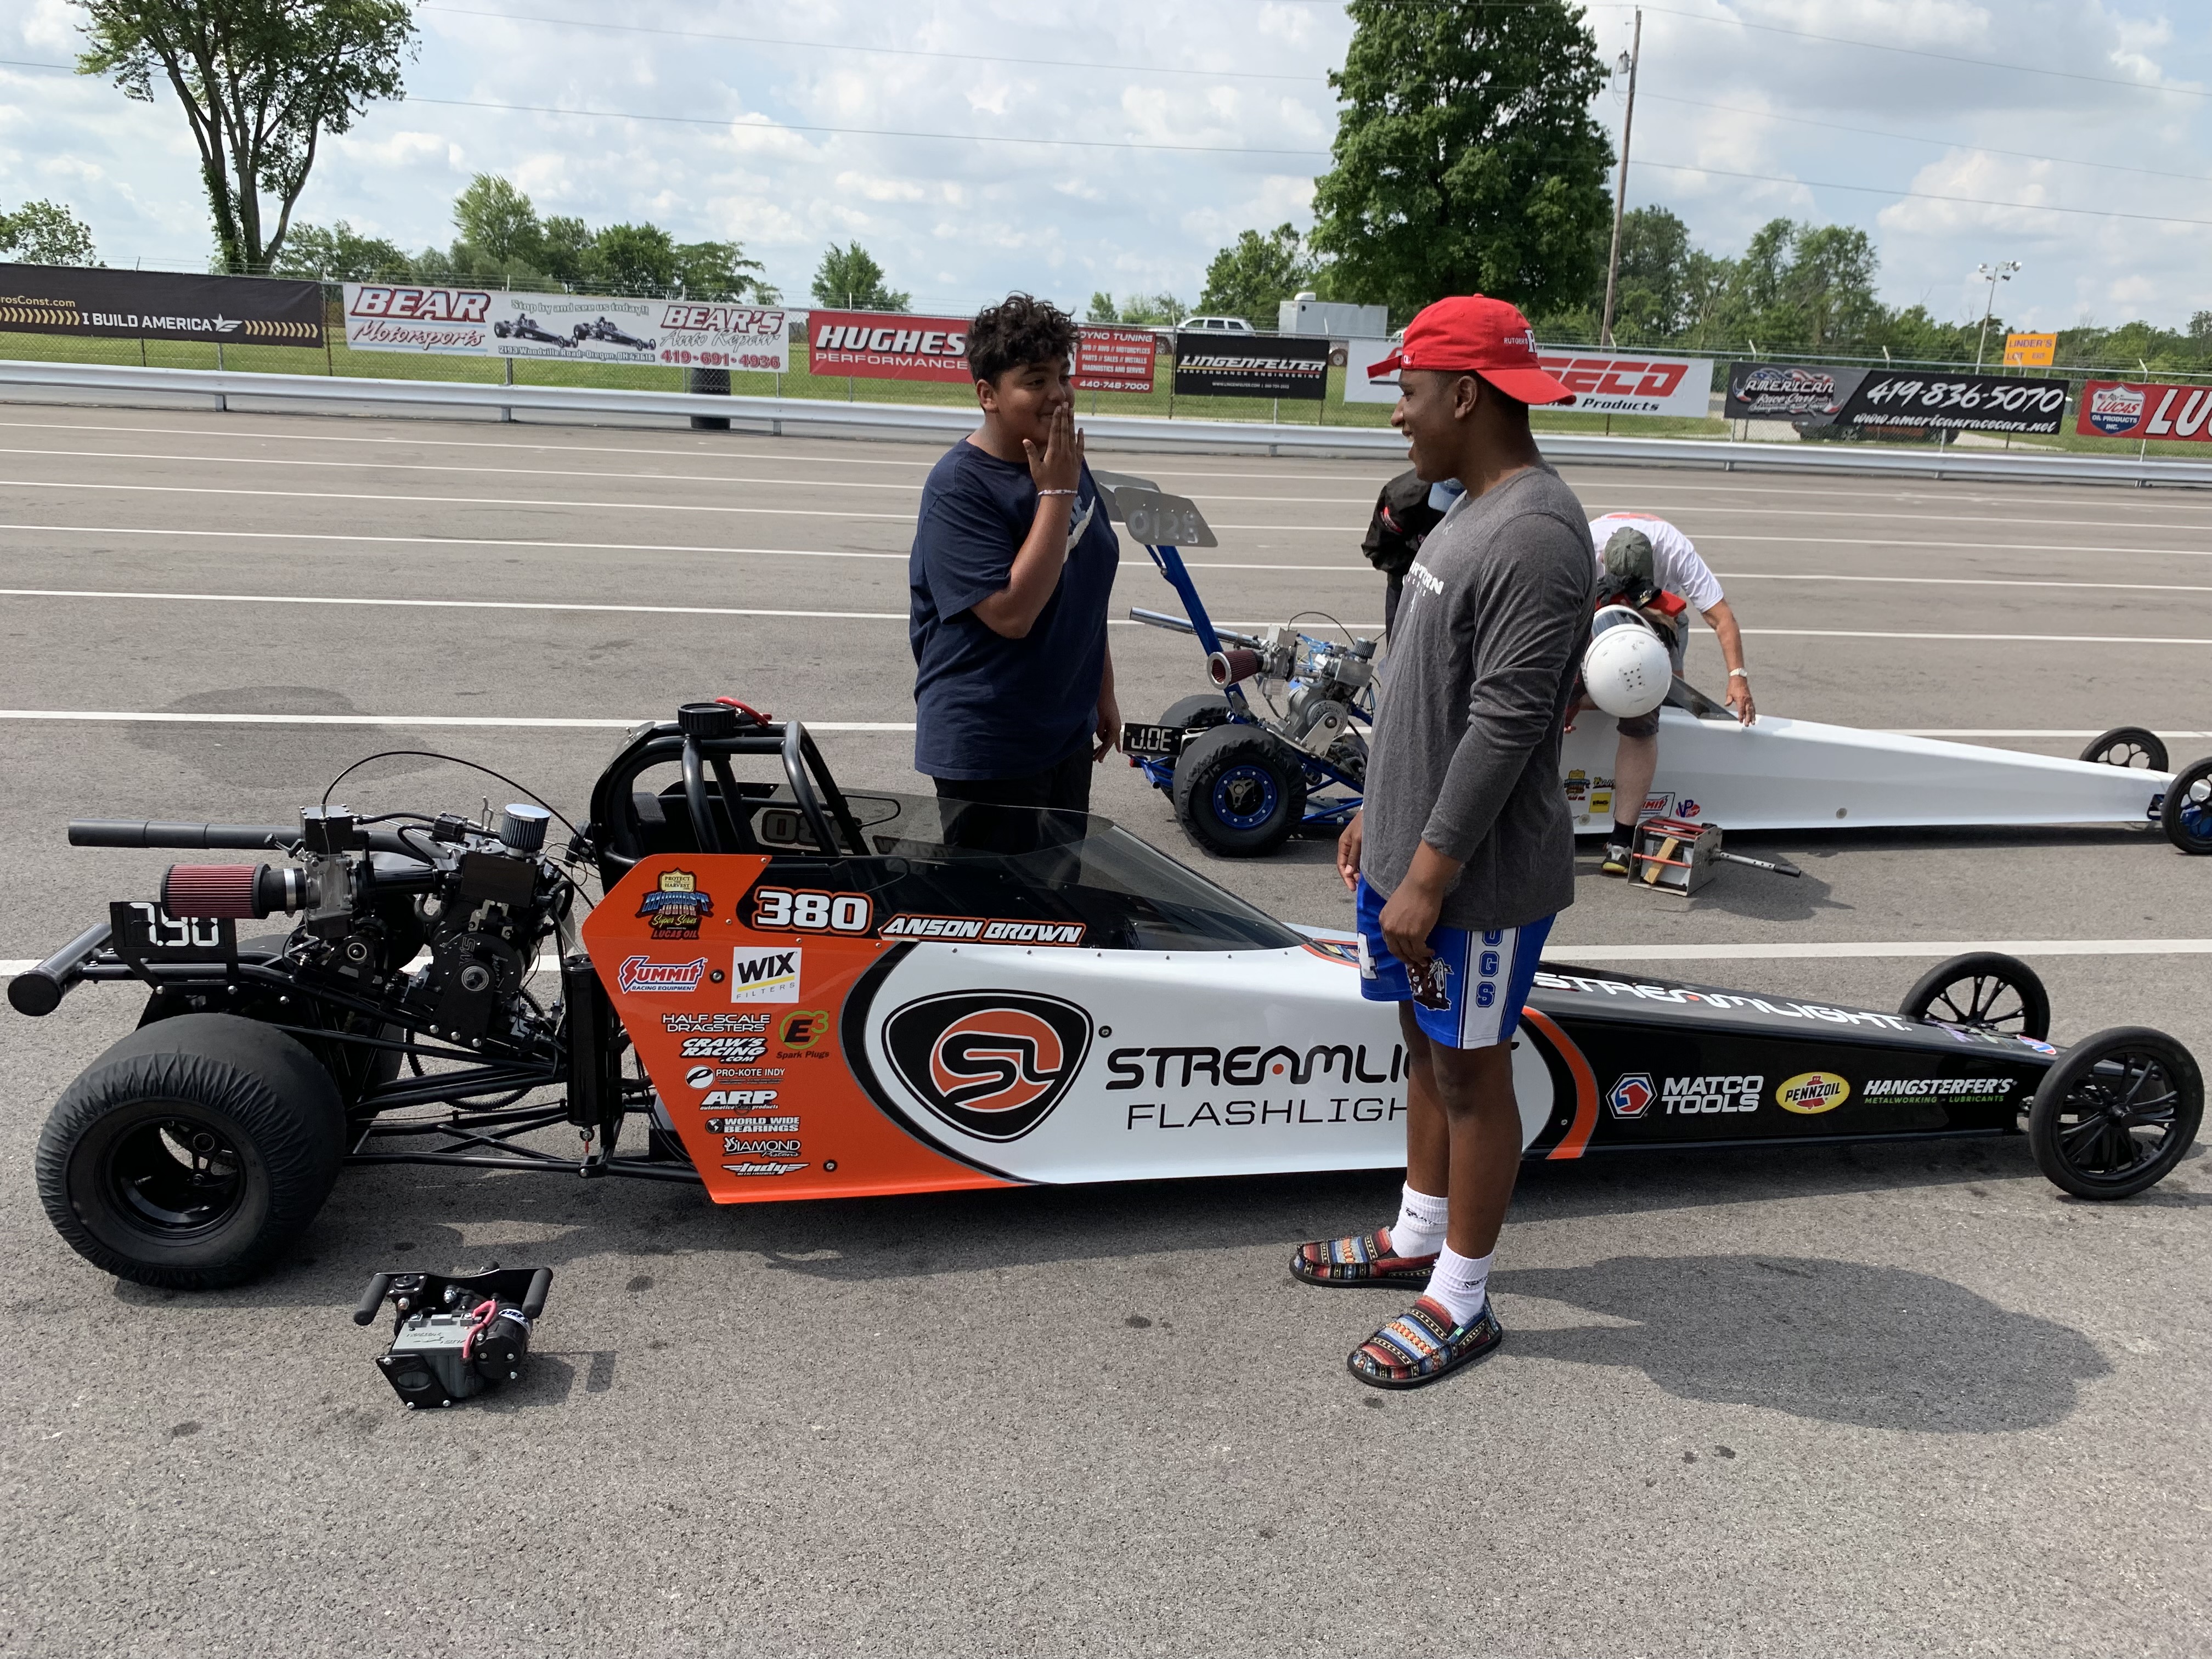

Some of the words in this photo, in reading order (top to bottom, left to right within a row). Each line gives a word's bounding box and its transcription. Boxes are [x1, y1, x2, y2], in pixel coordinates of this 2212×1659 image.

[0, 296, 76, 307] rosConst.com
[350, 287, 491, 323] BEAR
[511, 300, 537, 314] Stop
[538, 303, 552, 315] by
[554, 302, 574, 313] and
[574, 303, 595, 312] see
[596, 303, 610, 312] us
[611, 302, 650, 316] today!!
[82, 312, 90, 325] I
[92, 313, 138, 328] BUILD
[142, 315, 213, 331] AMERICA
[661, 305, 785, 334] BEAR'S
[352, 320, 486, 351] Motorsports
[659, 328, 708, 347] Auto
[712, 328, 781, 353] Repair
[816, 325, 967, 357] HUGHES
[1114, 333, 1153, 343] TUNING
[2009, 339, 2052, 348] LINDER'S
[498, 345, 518, 355] 2193
[519, 346, 559, 357] Woodville
[617, 352, 629, 361] OH
[815, 352, 968, 370] PERFORMANCE
[2006, 352, 2024, 360] LOT
[1082, 364, 1114, 373] DIAGNOSTICS
[1126, 366, 1146, 374] SERVICE
[1180, 356, 1326, 371] LINGENFELTER
[1745, 380, 1835, 393] AMERICAN
[1867, 377, 2065, 413] 419-836-5070
[1581, 398, 1660, 411] Products
[2096, 401, 2140, 414] LUCAS
[2144, 388, 2212, 437] LU
[1853, 413, 2058, 433] www.americanracecars.net
[2103, 415, 2138, 424] PRODUCTS
[641, 891, 709, 912] MIDWEST
[658, 904, 696, 916] JUNIOR
[757, 891, 868, 930] 380
[651, 914, 675, 928] Super
[675, 914, 697, 926] Series
[653, 930, 682, 938] LUCAS
[683, 930, 697, 938] OIL
[882, 918, 985, 938] ANSON
[983, 922, 1082, 943] BROWN
[623, 960, 699, 986] SUMMIT
[737, 951, 795, 984] WIX
[736, 982, 795, 1000] FILTERS
[663, 1014, 708, 1024] HALF
[713, 1014, 771, 1024] SCALE
[667, 1023, 765, 1032] DRAGSTERS
[781, 1010, 829, 1046] E3
[682, 1037, 766, 1047] CRAW'S
[681, 1047, 766, 1056] RACING
[776, 1051, 802, 1060] Spark
[805, 1050, 830, 1059] Plugs
[716, 1068, 762, 1077] PRO-KOTE
[765, 1068, 786, 1076] INDY
[1105, 1044, 1409, 1090] STREAMLI
[1663, 1075, 1764, 1096] MATCO
[1785, 1082, 1841, 1102] PENNZOIL
[1863, 1079, 2015, 1095] HANGSTERFER'S
[701, 1090, 778, 1105] ARP
[1661, 1093, 1760, 1114] TOOLS
[1126, 1098, 1408, 1130] FLASHLIGH
[724, 1125, 799, 1133] BEARINGS
[726, 1140, 801, 1152] DIAMOND
[740, 1162, 789, 1175] Indy
